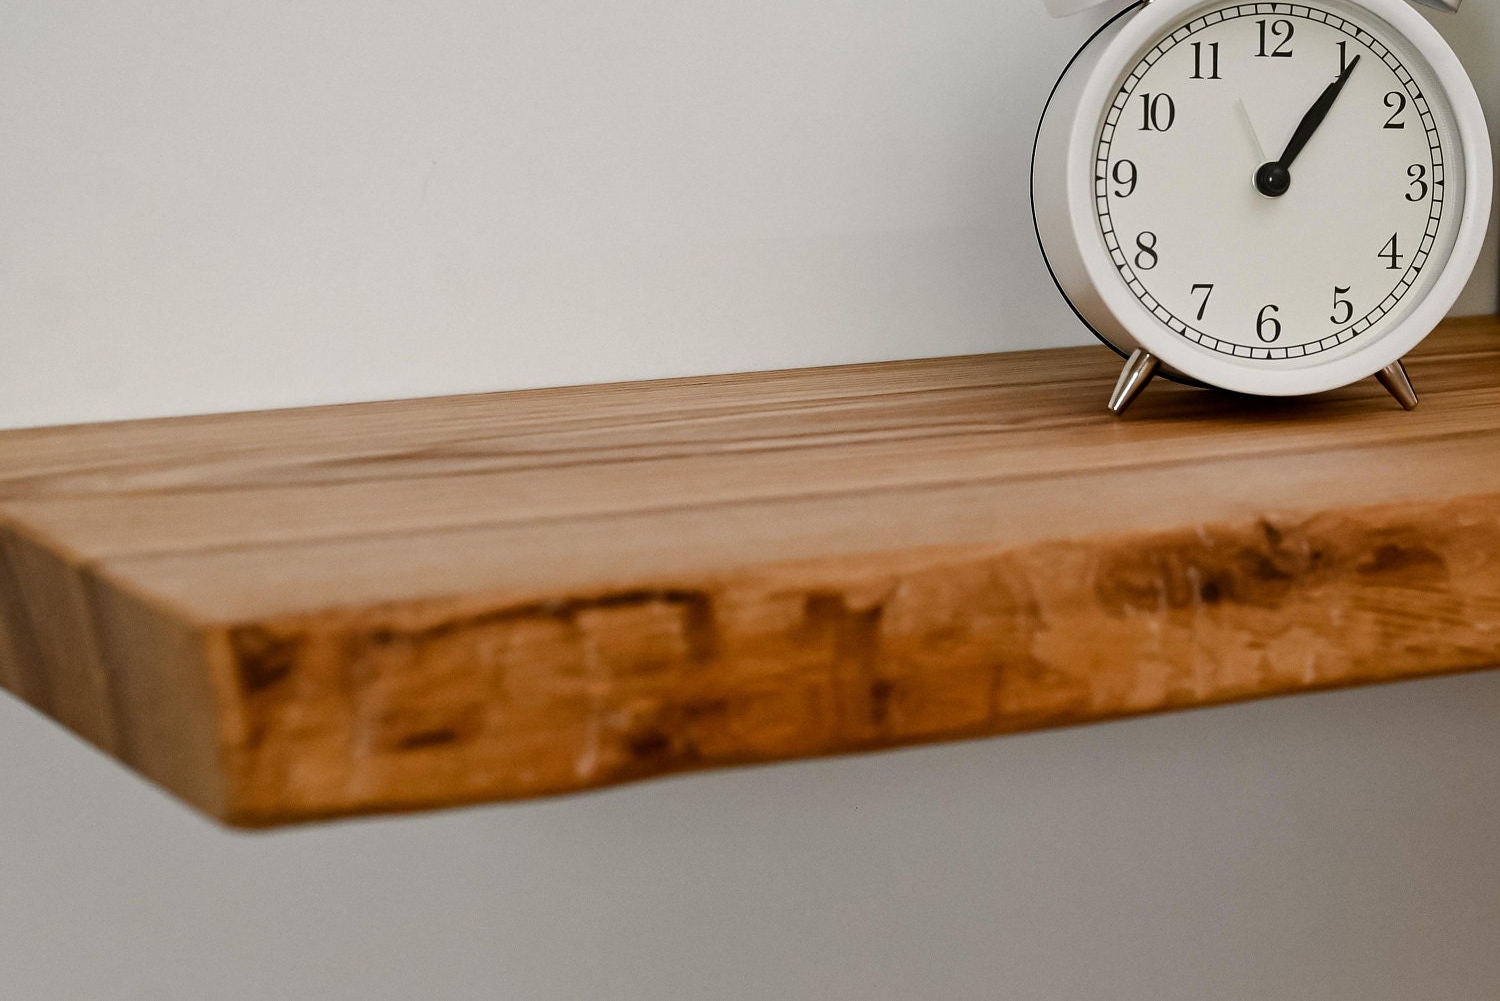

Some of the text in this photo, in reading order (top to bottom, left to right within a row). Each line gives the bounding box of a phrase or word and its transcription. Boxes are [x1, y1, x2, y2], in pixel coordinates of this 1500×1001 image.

[1255, 19, 1295, 58] 12
[1188, 42, 1222, 80] 11
[1334, 40, 1347, 78] 1
[1138, 93, 1176, 132] 10
[1383, 91, 1407, 130] 2
[1113, 160, 1137, 197] 9
[1405, 164, 1427, 201] 3
[1134, 231, 1158, 271] 8
[1378, 233, 1403, 269] 4
[1191, 284, 1213, 320] 7
[1330, 286, 1354, 325] 5
[1257, 305, 1281, 342] 6
